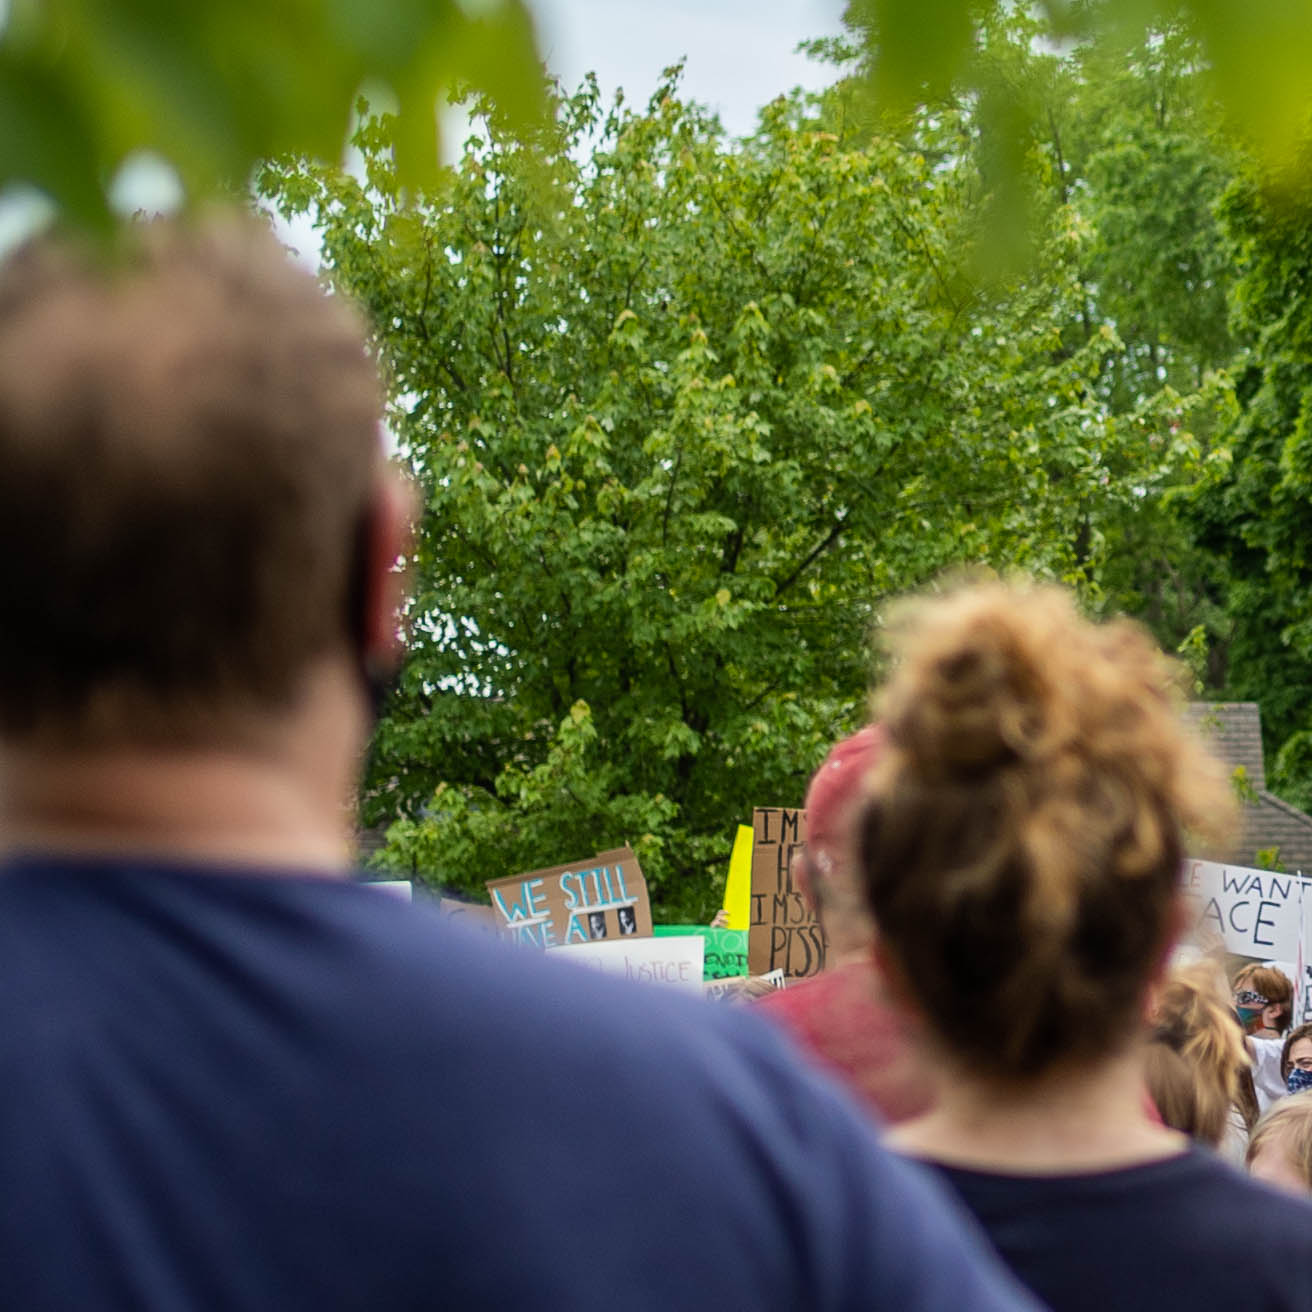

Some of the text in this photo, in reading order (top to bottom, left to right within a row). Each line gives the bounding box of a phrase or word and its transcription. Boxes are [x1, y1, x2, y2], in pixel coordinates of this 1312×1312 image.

[492, 865, 639, 922] WE STILL
[1223, 870, 1312, 901] WANT
[565, 913, 589, 945] A
